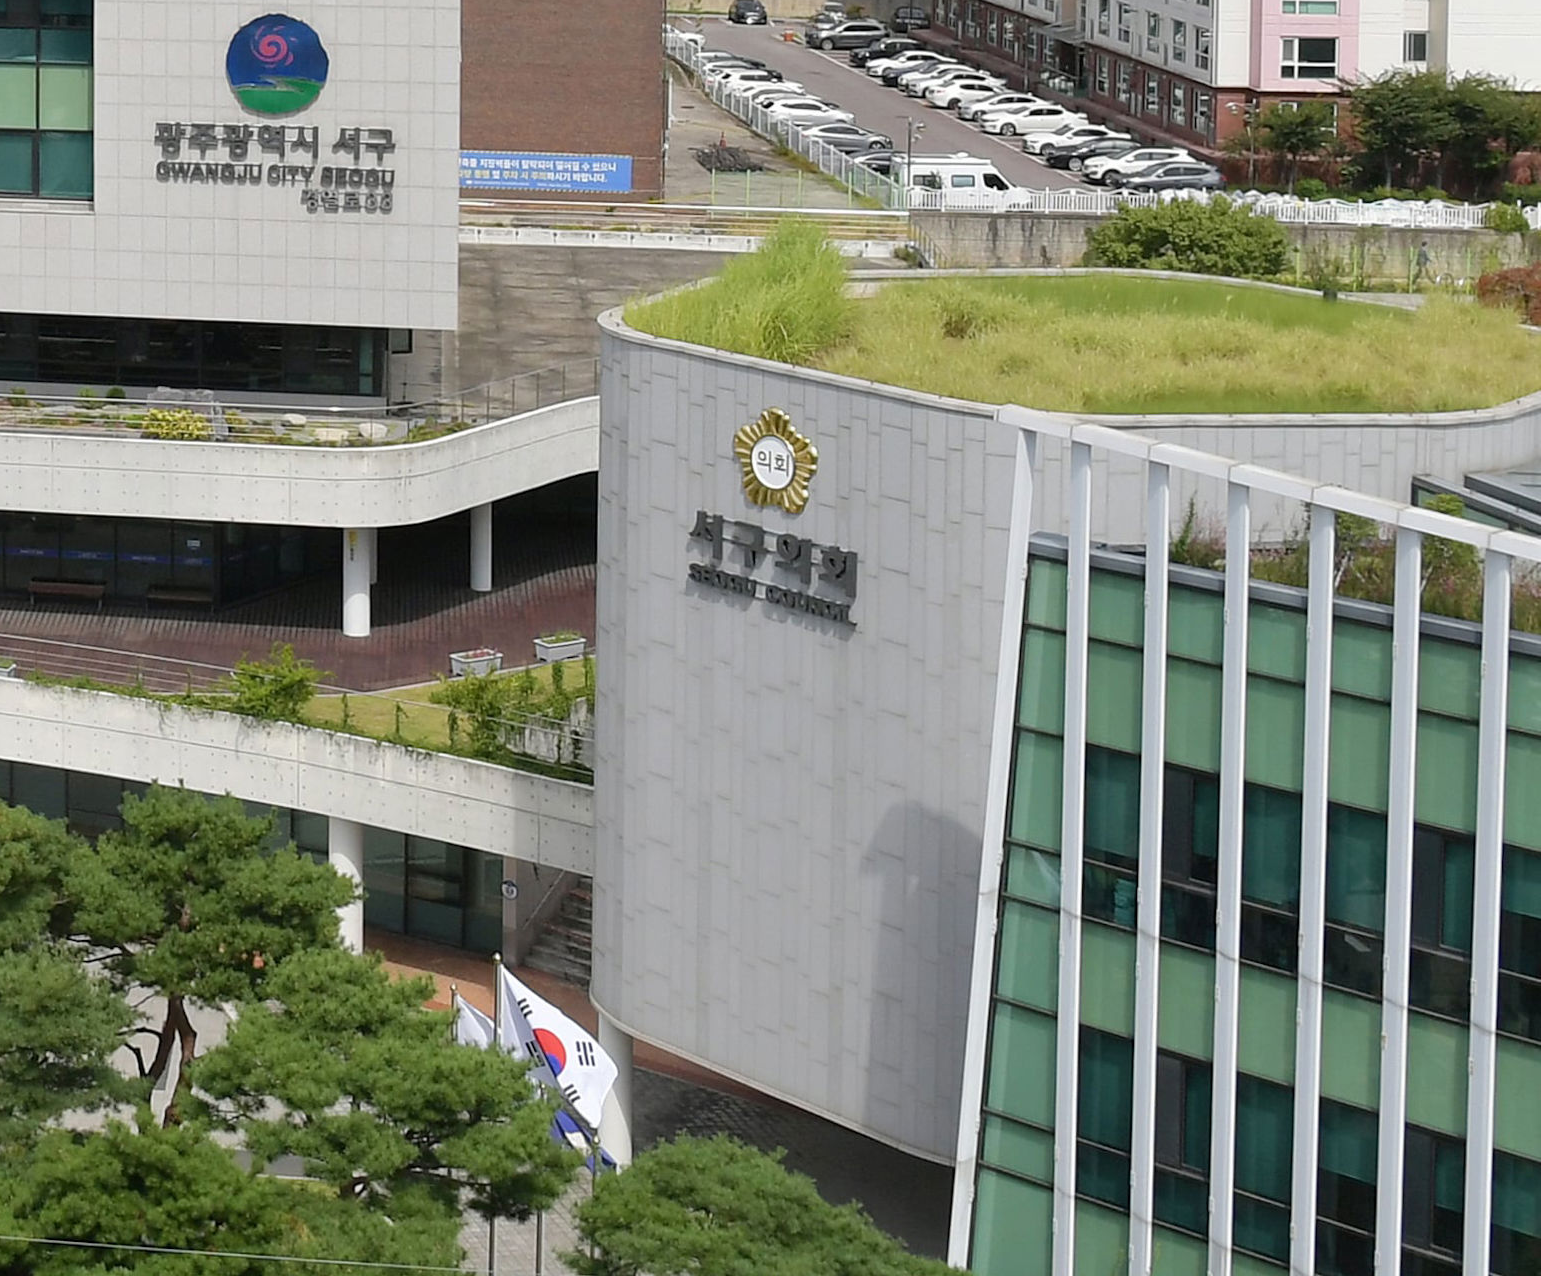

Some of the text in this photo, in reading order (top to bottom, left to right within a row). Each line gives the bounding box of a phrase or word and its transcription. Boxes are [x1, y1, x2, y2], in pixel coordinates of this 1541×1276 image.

[154, 122, 396, 165] 광주광역시 서구
[156, 161, 395, 192] GWANGJU CITY SEOGU
[756, 449, 790, 477] 의회
[688, 510, 858, 599] 서구의회
